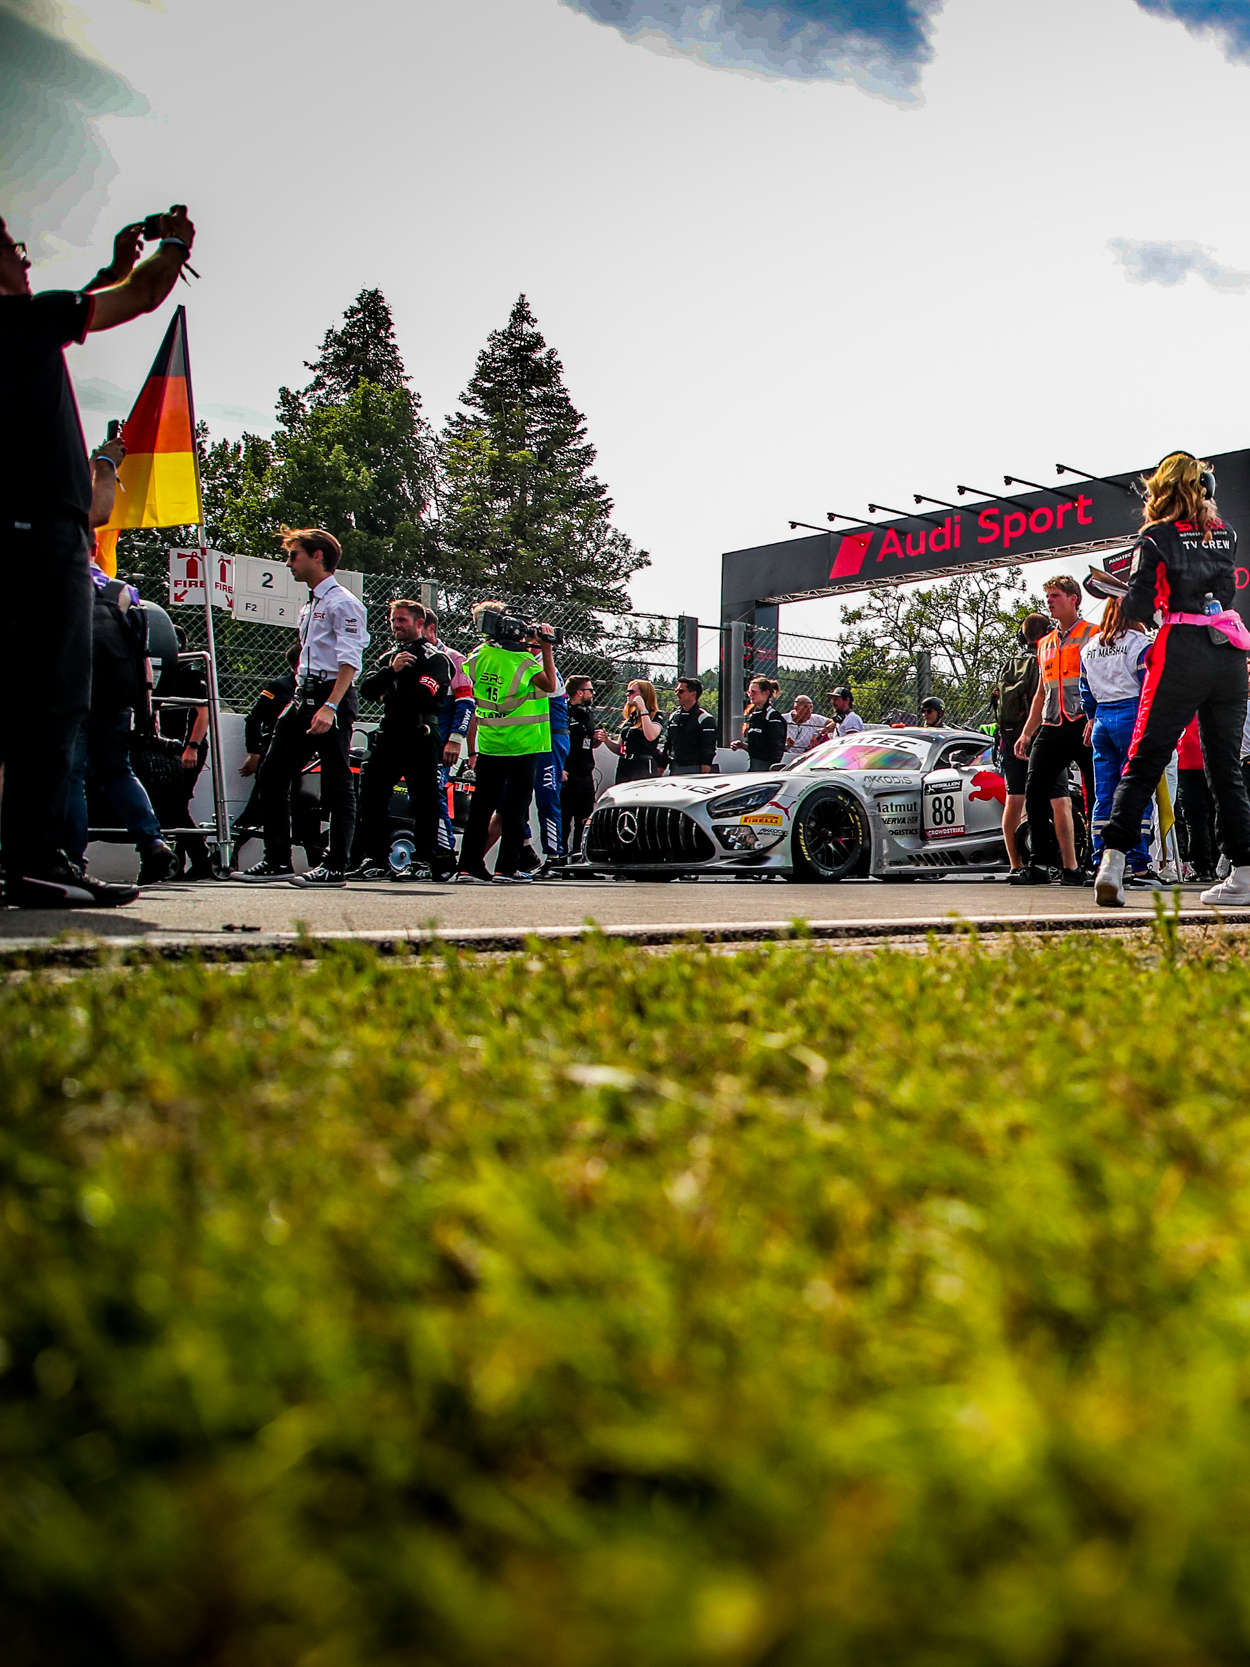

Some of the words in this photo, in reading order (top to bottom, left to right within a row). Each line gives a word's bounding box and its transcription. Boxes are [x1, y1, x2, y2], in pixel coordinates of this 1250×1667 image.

[876, 514, 962, 562] Audi
[977, 494, 1093, 548] Sport
[1183, 540, 1198, 550] TV
[1202, 540, 1230, 549] CREW
[1108, 552, 1132, 565] FANATEC
[174, 579, 206, 588] FIRE
[261, 572, 274, 589] 2
[214, 581, 233, 594] FIRE
[245, 602, 258, 613] F2
[278, 608, 285, 616] 2
[1086, 649, 1097, 659] PIT
[1099, 645, 1128, 658] MARSHAL
[486, 686, 498, 702] 15
[543, 764, 554, 790] ADA
[931, 795, 956, 826] 88
[744, 815, 780, 824] PIRELLI
[927, 826, 965, 836] CROWDSTRIKE
